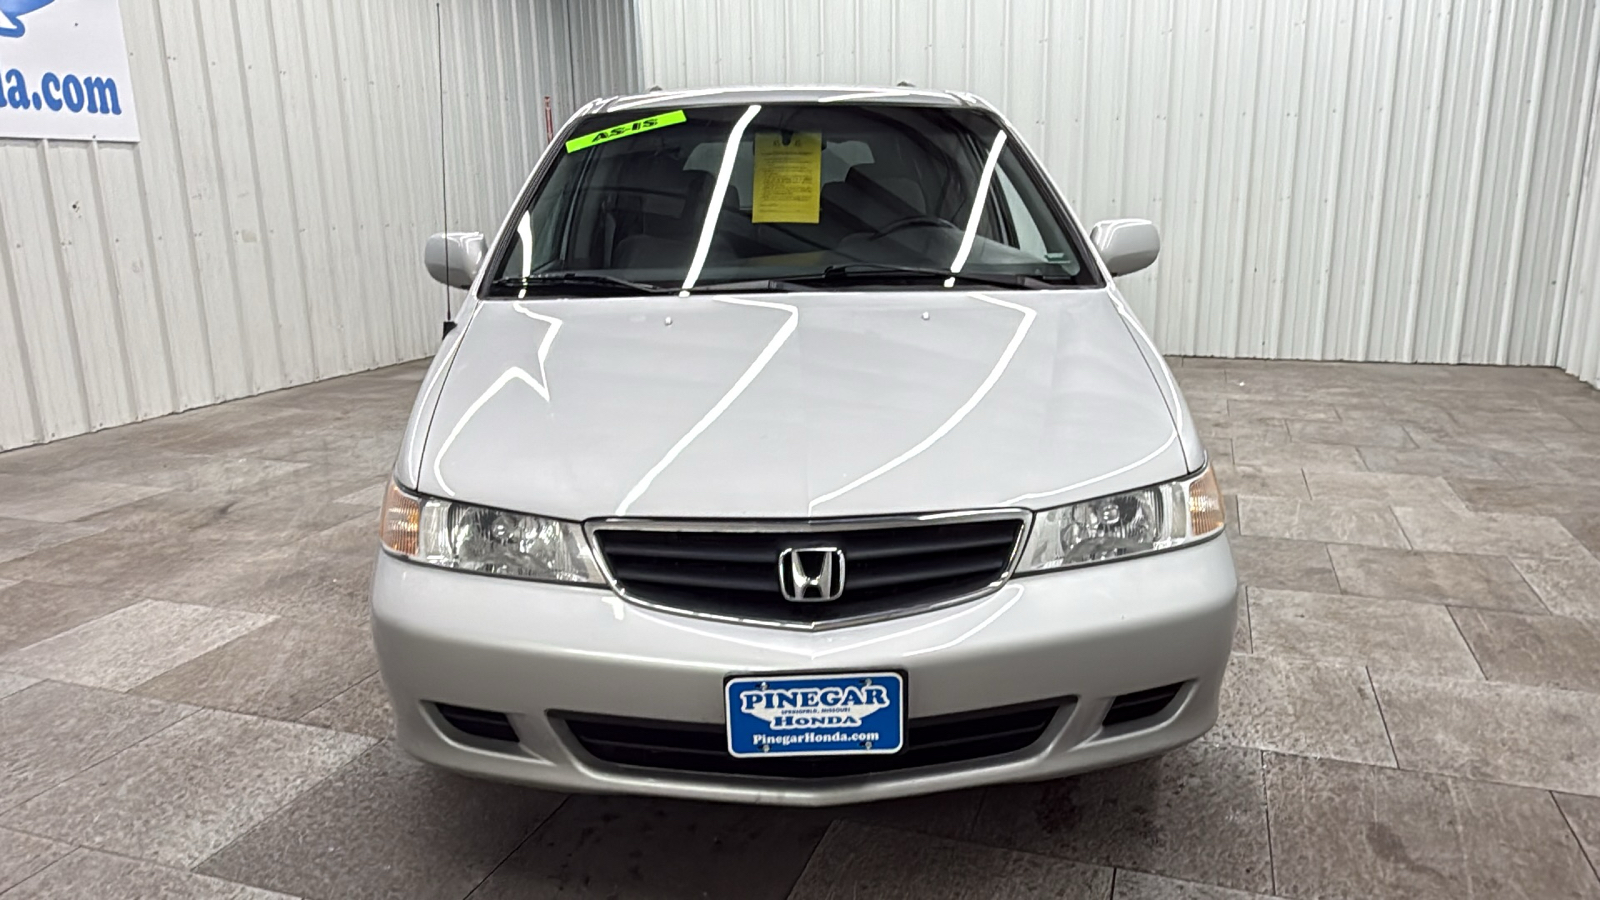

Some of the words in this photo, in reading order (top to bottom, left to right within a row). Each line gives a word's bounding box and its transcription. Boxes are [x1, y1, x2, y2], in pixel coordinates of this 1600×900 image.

[592, 118, 659, 143] AS-IS
[744, 686, 888, 711] PINEGAR
[774, 715, 858, 727] HONDA
[752, 731, 880, 746] PinegarHonda.com
